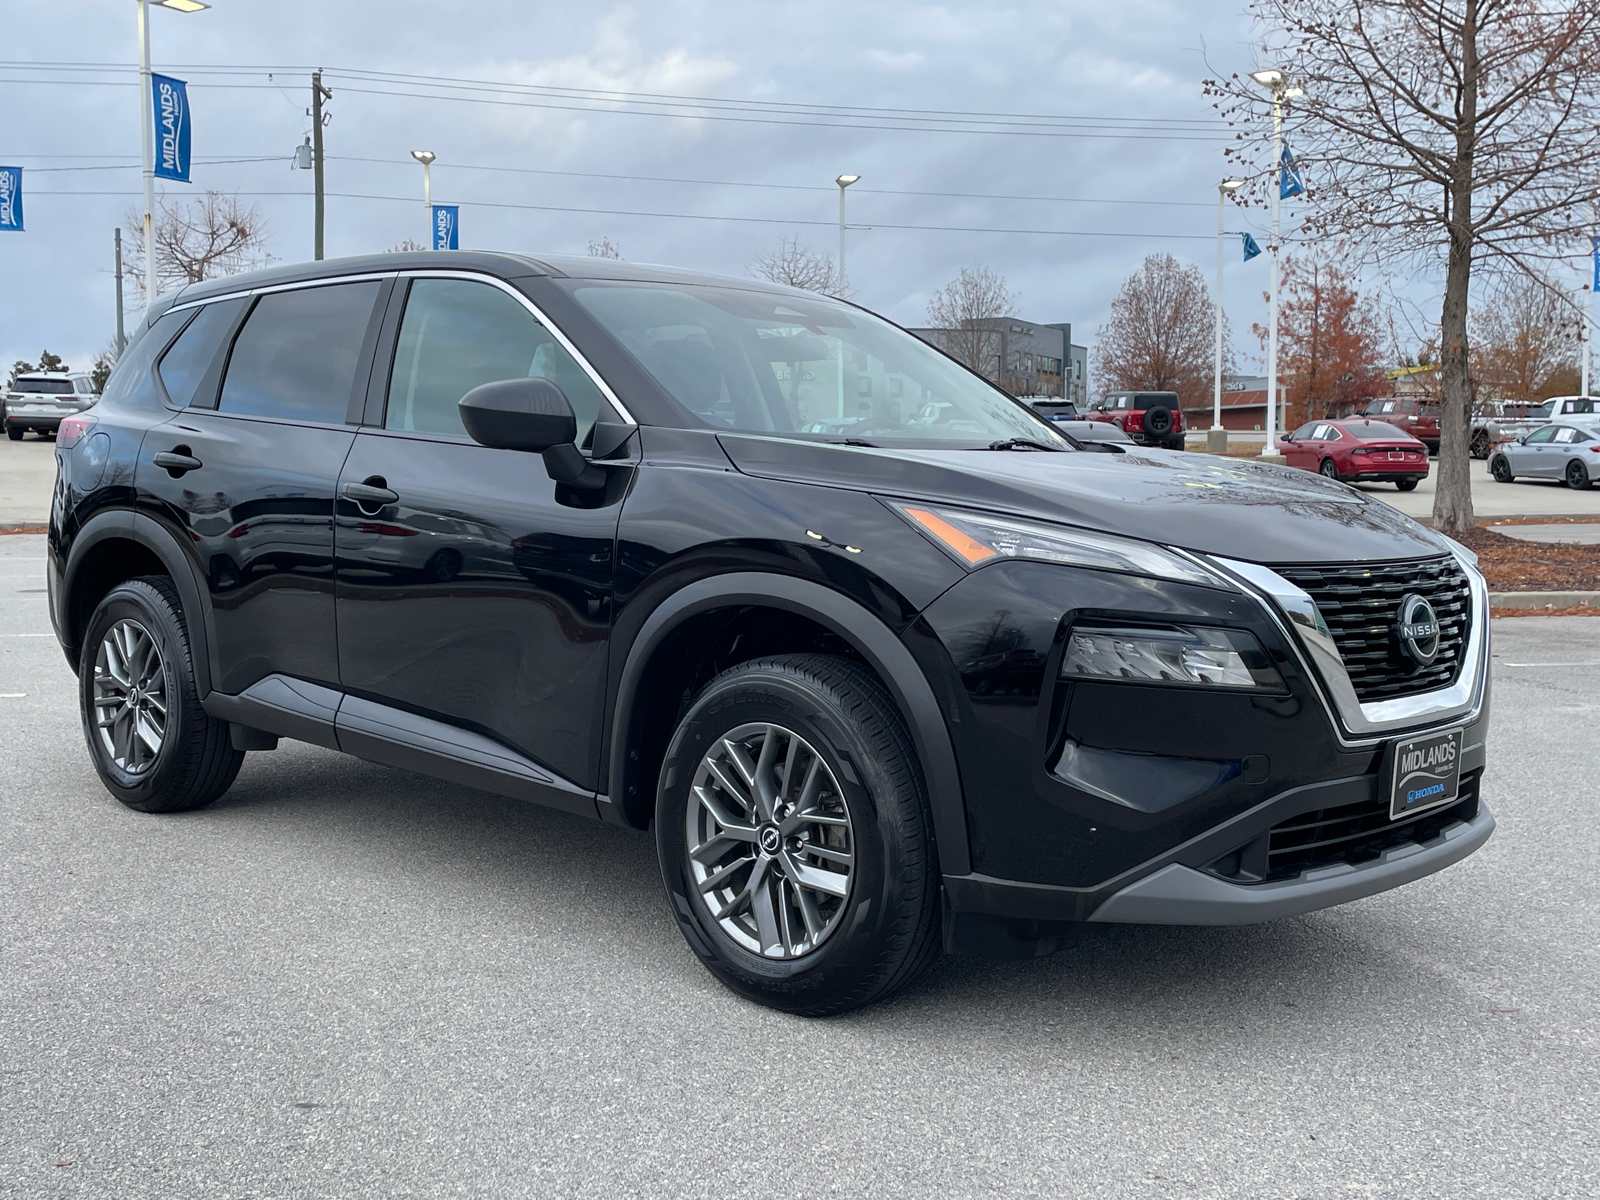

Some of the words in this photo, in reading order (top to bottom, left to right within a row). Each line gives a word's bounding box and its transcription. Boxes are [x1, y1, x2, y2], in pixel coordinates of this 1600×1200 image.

[160, 83, 174, 169] MIDLANDS
[0, 171, 10, 224] MIDLANDS
[437, 210, 446, 250] DLANDS
[1401, 741, 1456, 773] MIDLANDS
[1415, 783, 1444, 799] HONDA
